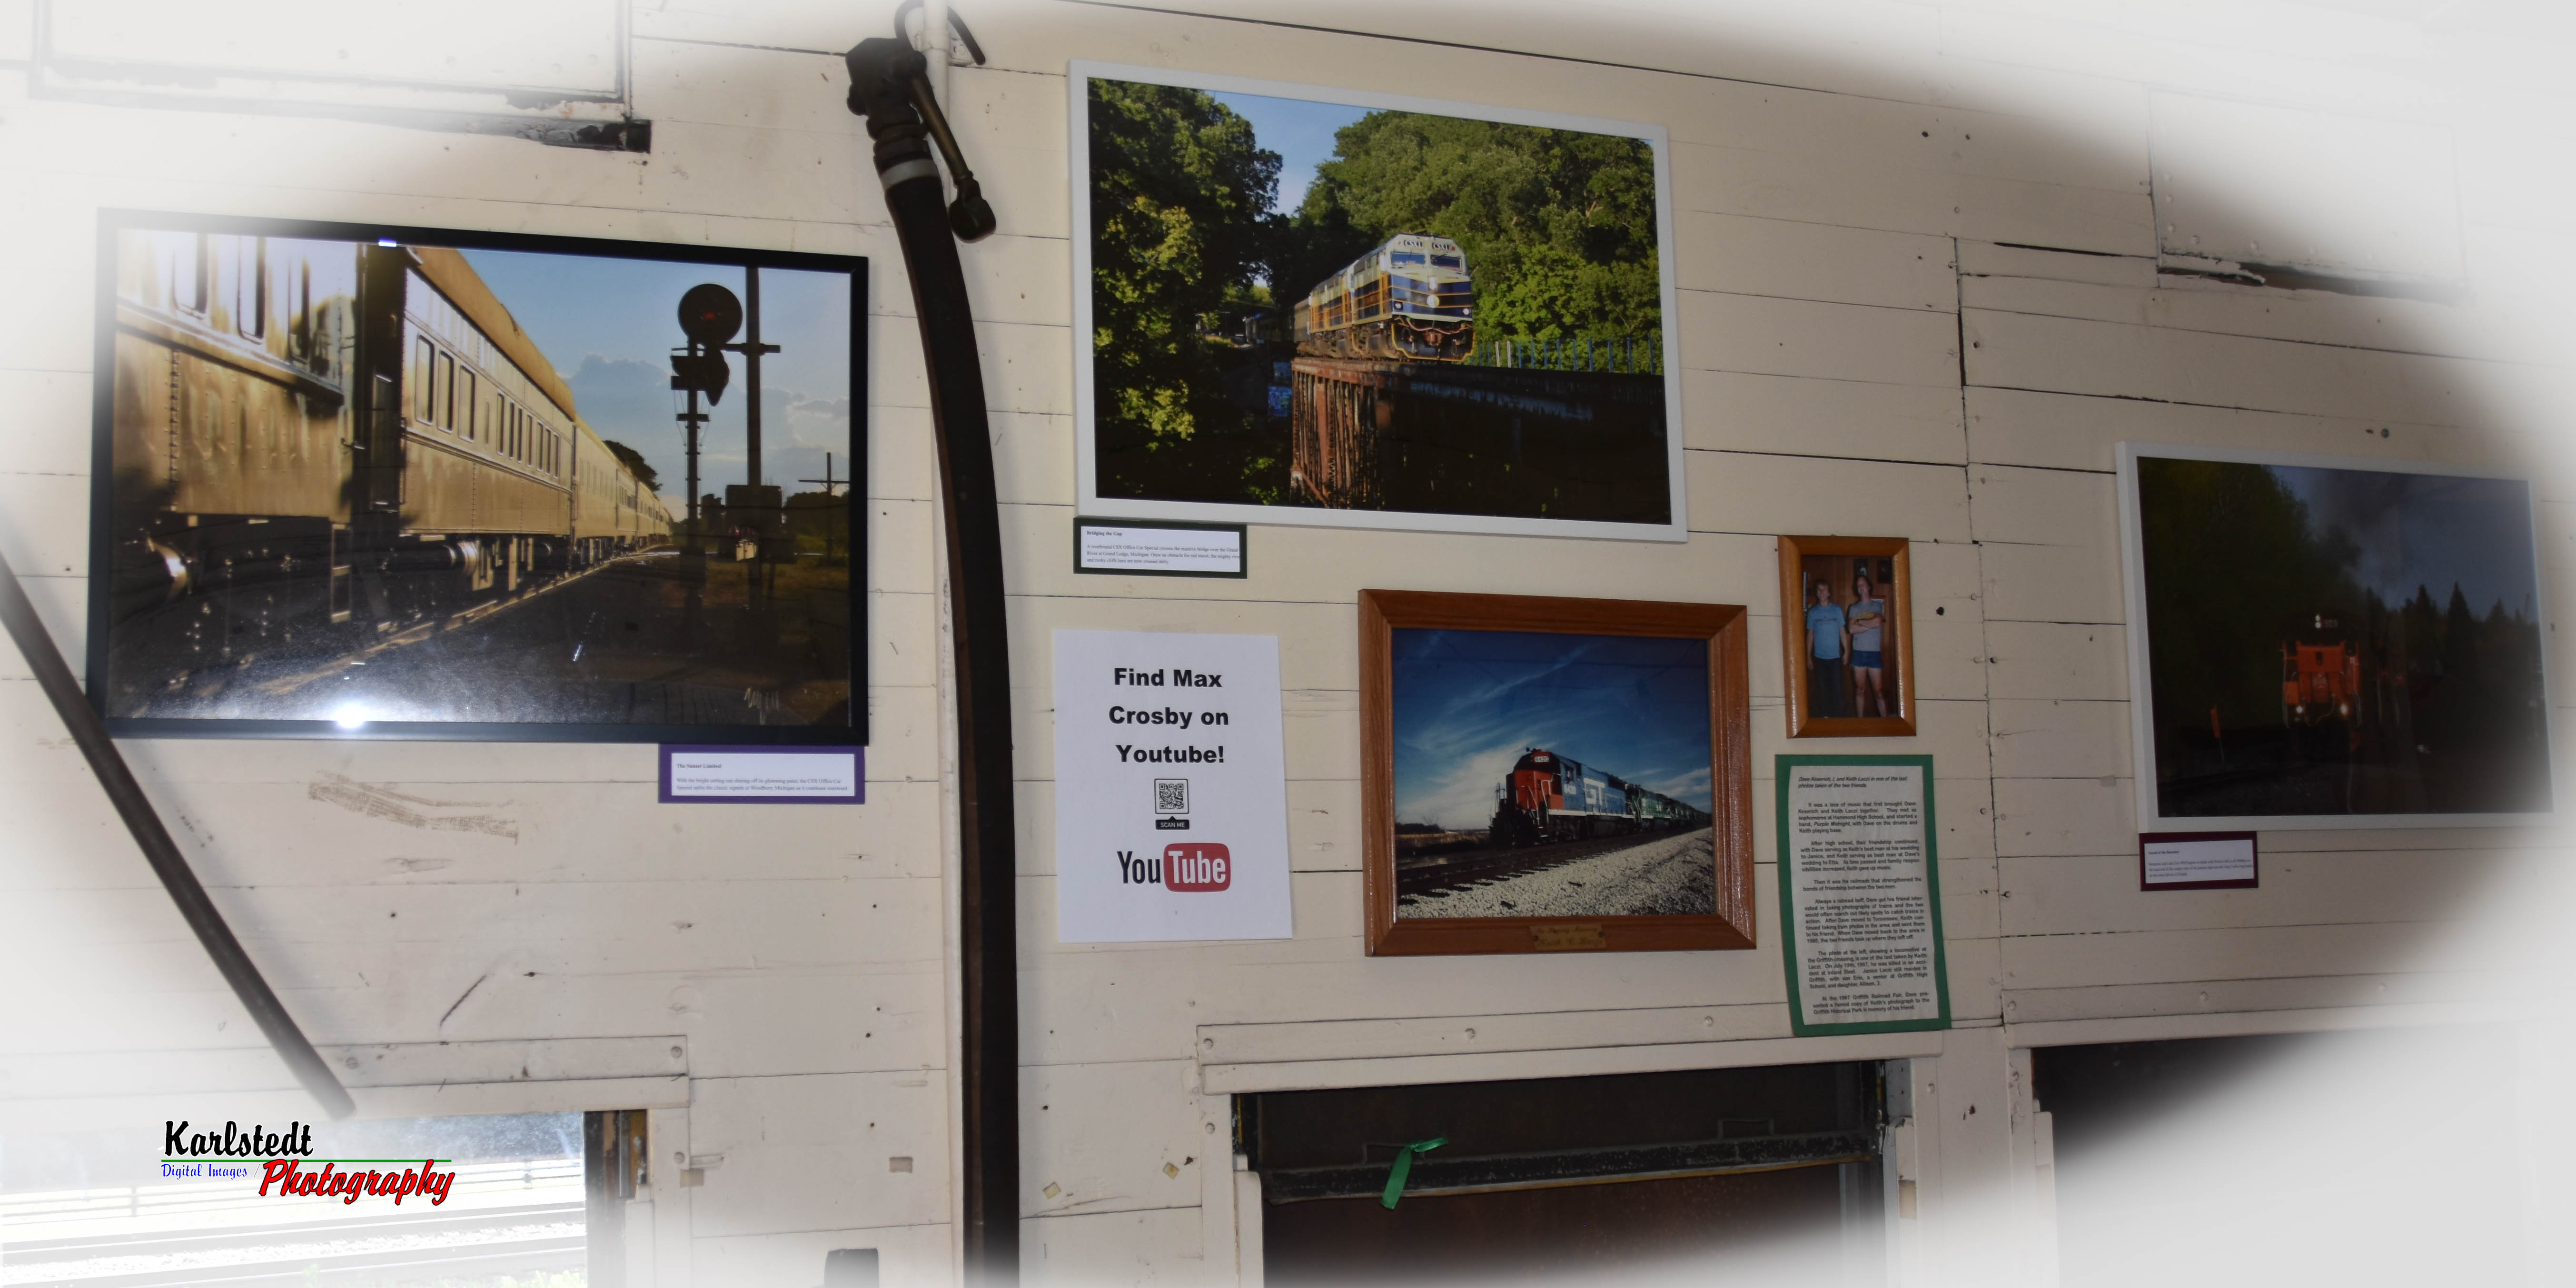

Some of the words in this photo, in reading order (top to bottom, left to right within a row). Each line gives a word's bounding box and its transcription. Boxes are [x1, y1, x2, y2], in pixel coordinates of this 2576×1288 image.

[1405, 239, 1421, 248] CSX1
[1114, 668, 1164, 686] Find
[1173, 670, 1222, 687] Max
[1109, 706, 1192, 729] Crosby
[1201, 711, 1229, 725] on
[1116, 745, 1224, 763] Youtube!
[1117, 850, 1226, 884] YouTube
